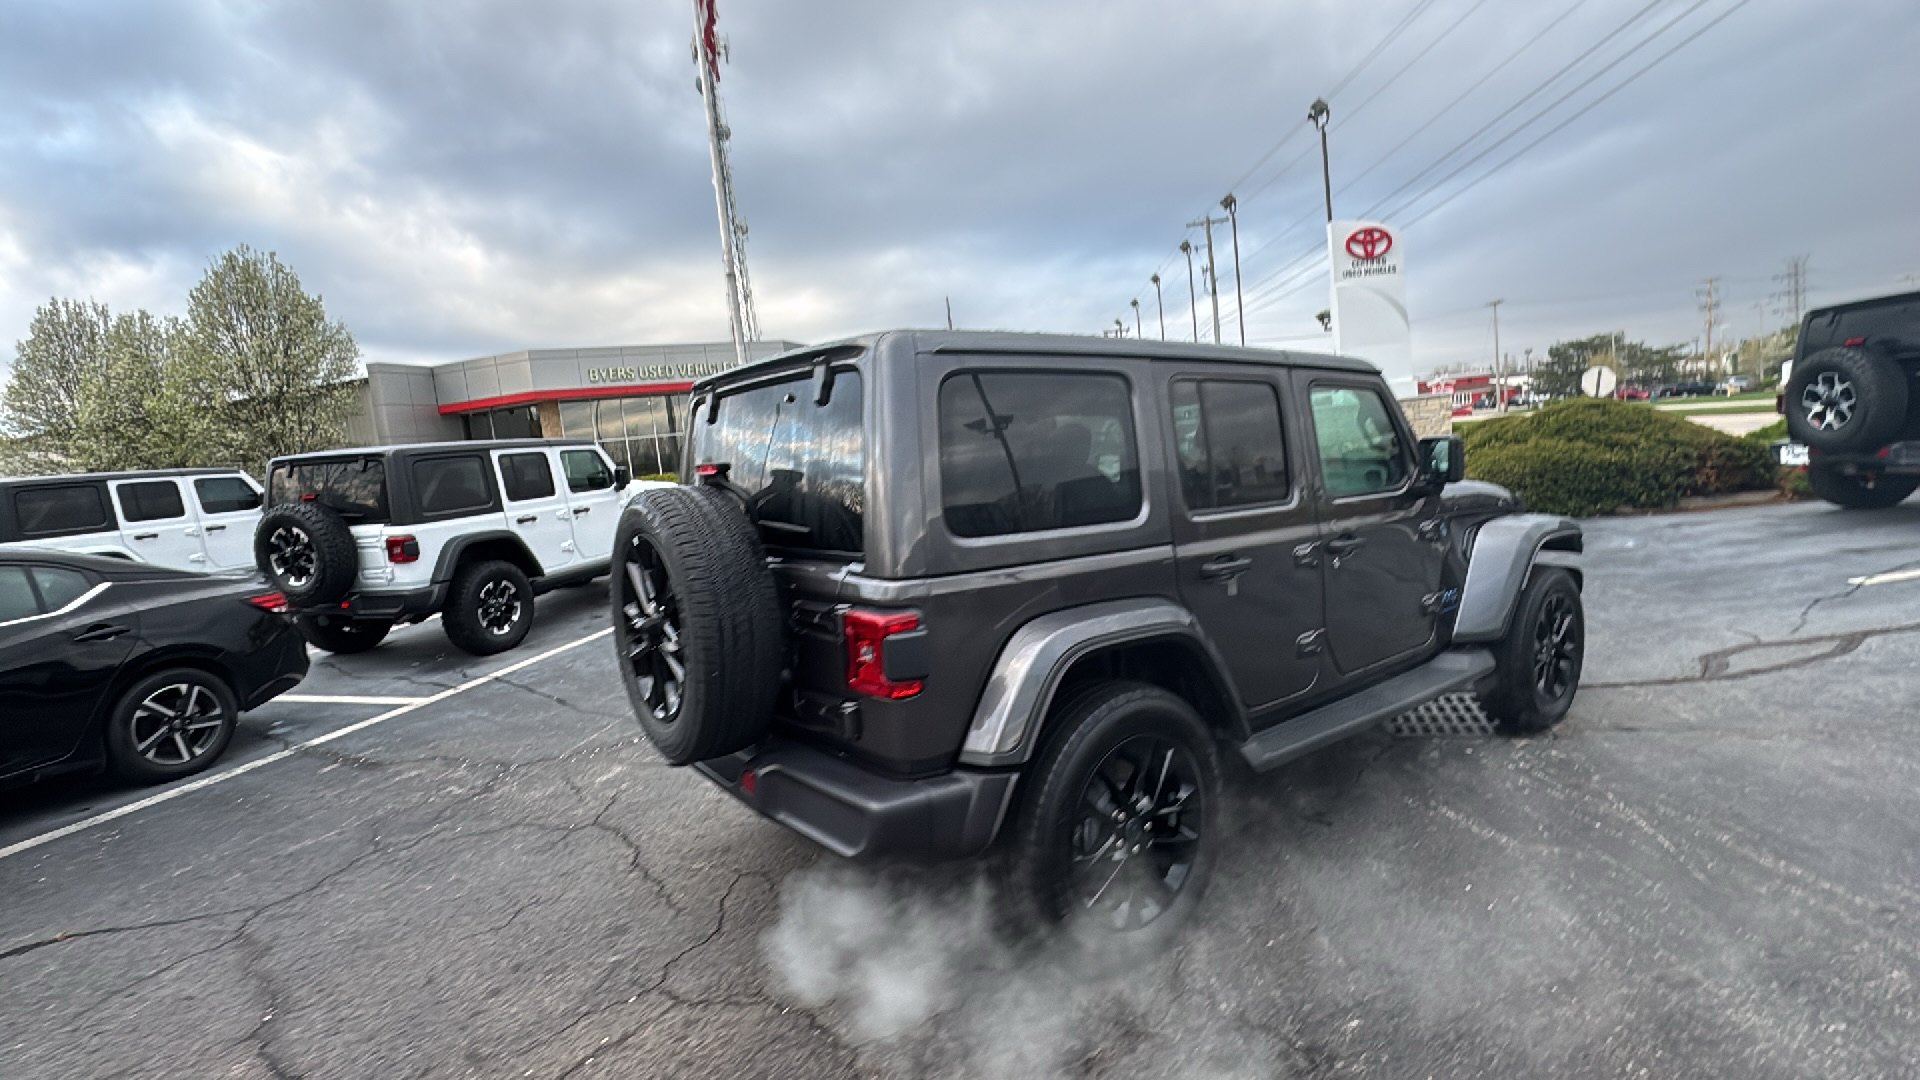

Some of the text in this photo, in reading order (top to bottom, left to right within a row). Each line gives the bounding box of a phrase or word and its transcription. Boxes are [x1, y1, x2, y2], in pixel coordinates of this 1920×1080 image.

[1342, 268, 1362, 279] USED
[588, 366, 635, 383] BYERS
[638, 364, 675, 380] USED
